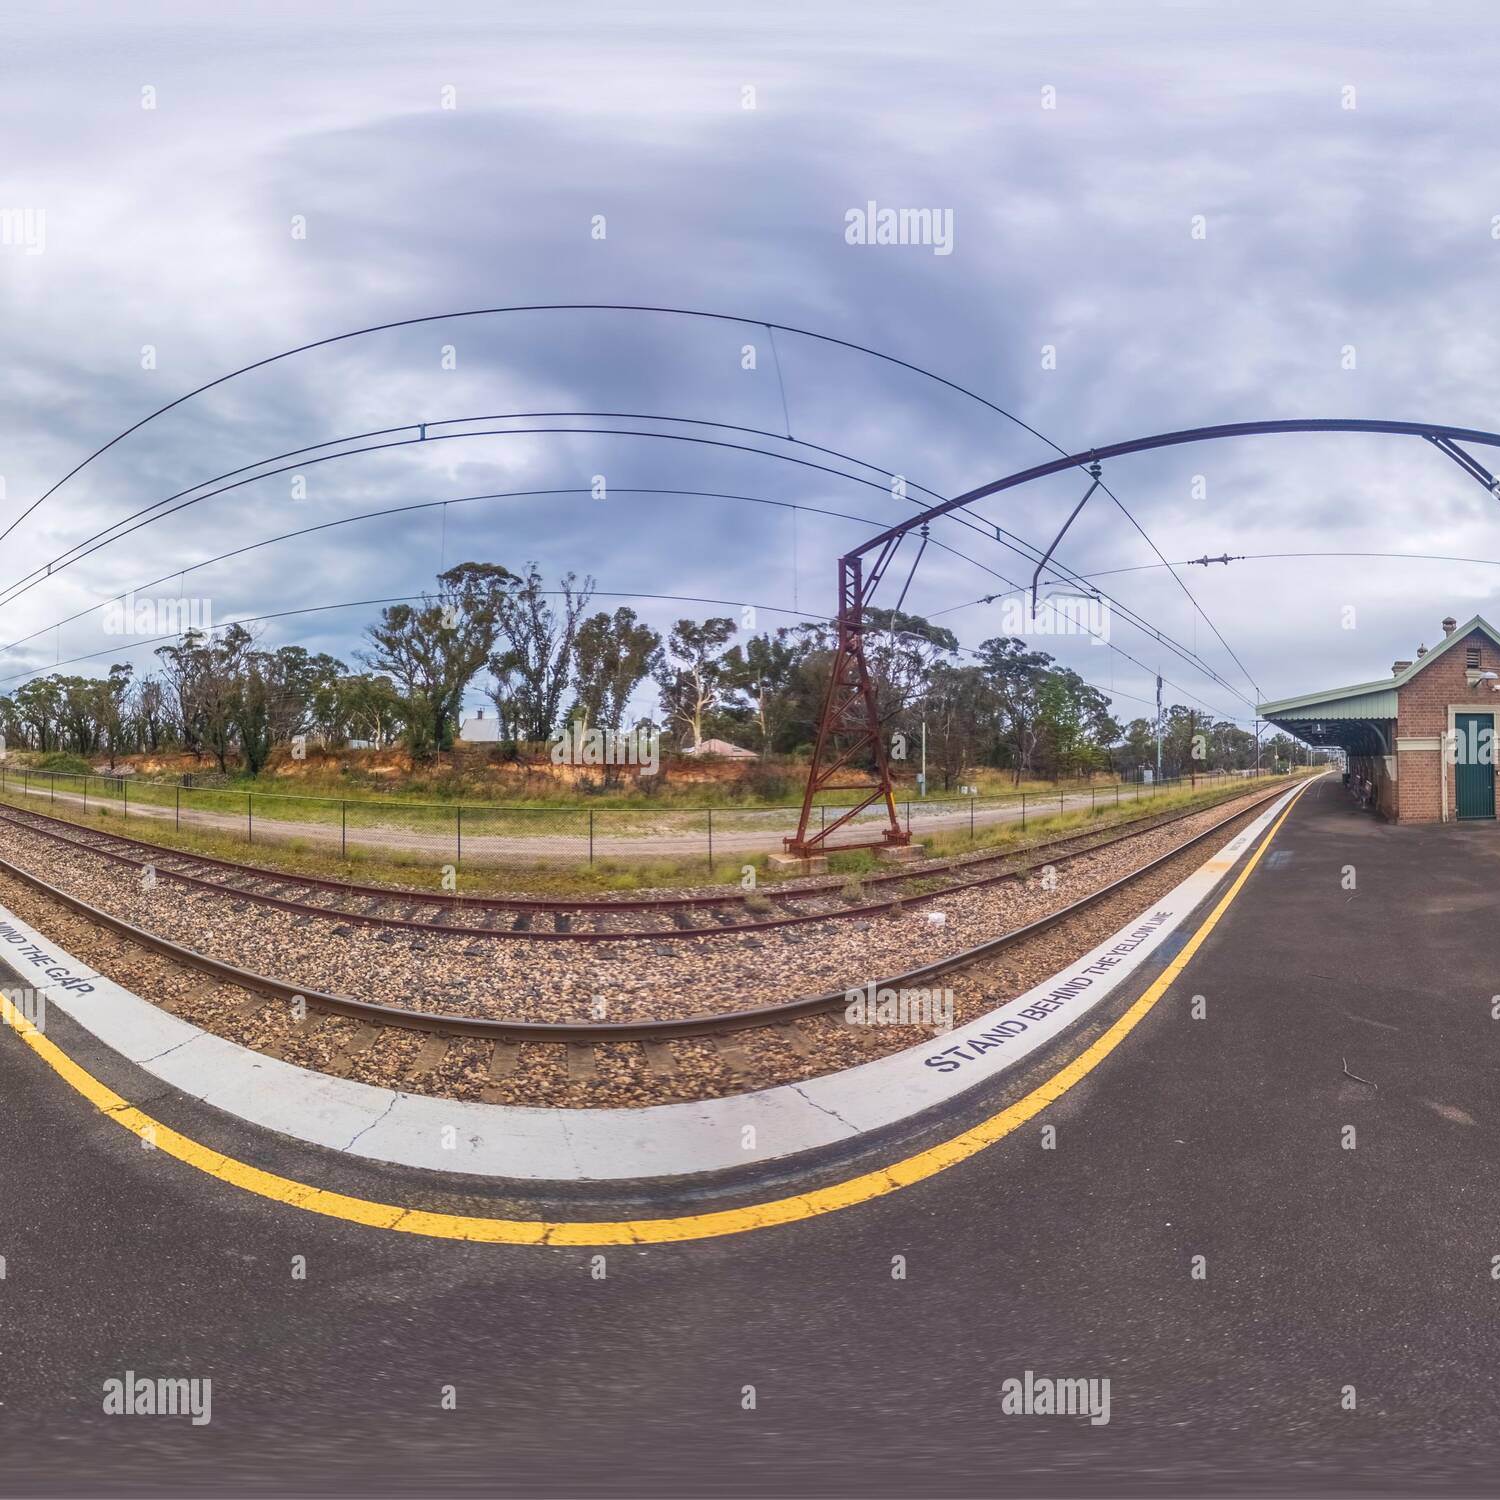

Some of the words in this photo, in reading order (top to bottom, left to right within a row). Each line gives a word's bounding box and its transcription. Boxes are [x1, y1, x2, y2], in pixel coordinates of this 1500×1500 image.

[18, 944, 57, 967] THE
[45, 967, 95, 993] GAP
[924, 1020, 1028, 1072] STAND
[1017, 977, 1093, 1021] BEHIND
[1081, 956, 1122, 975] THE
[1106, 925, 1157, 956] YELLOW
[1145, 911, 1173, 926] LINE
